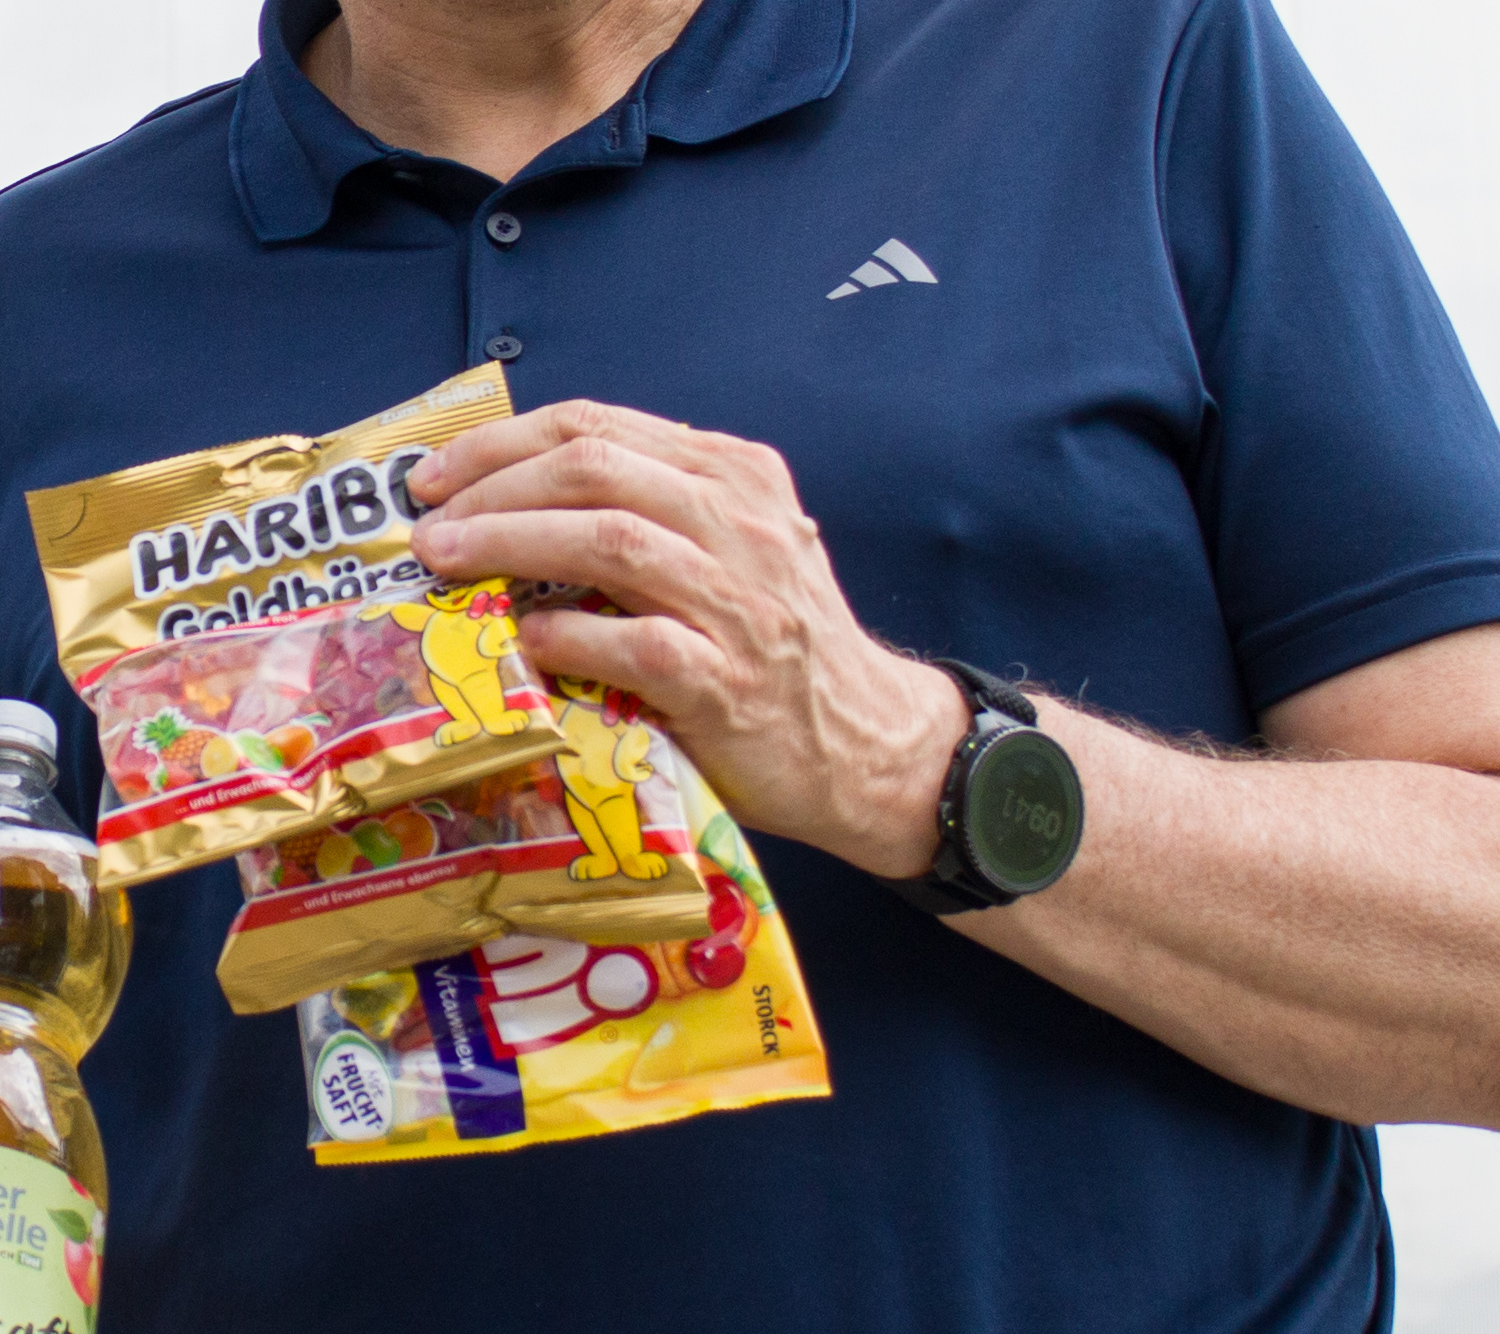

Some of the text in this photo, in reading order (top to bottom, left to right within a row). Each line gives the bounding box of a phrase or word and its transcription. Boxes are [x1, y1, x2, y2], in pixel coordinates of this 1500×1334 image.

[189, 792, 216, 810] und
[303, 892, 329, 911] und
[434, 965, 476, 1072] Vitaminen
[753, 985, 780, 1059] STORCK
[322, 1074, 358, 1125] SAFT
[337, 1053, 384, 1129] FRUCHT-
